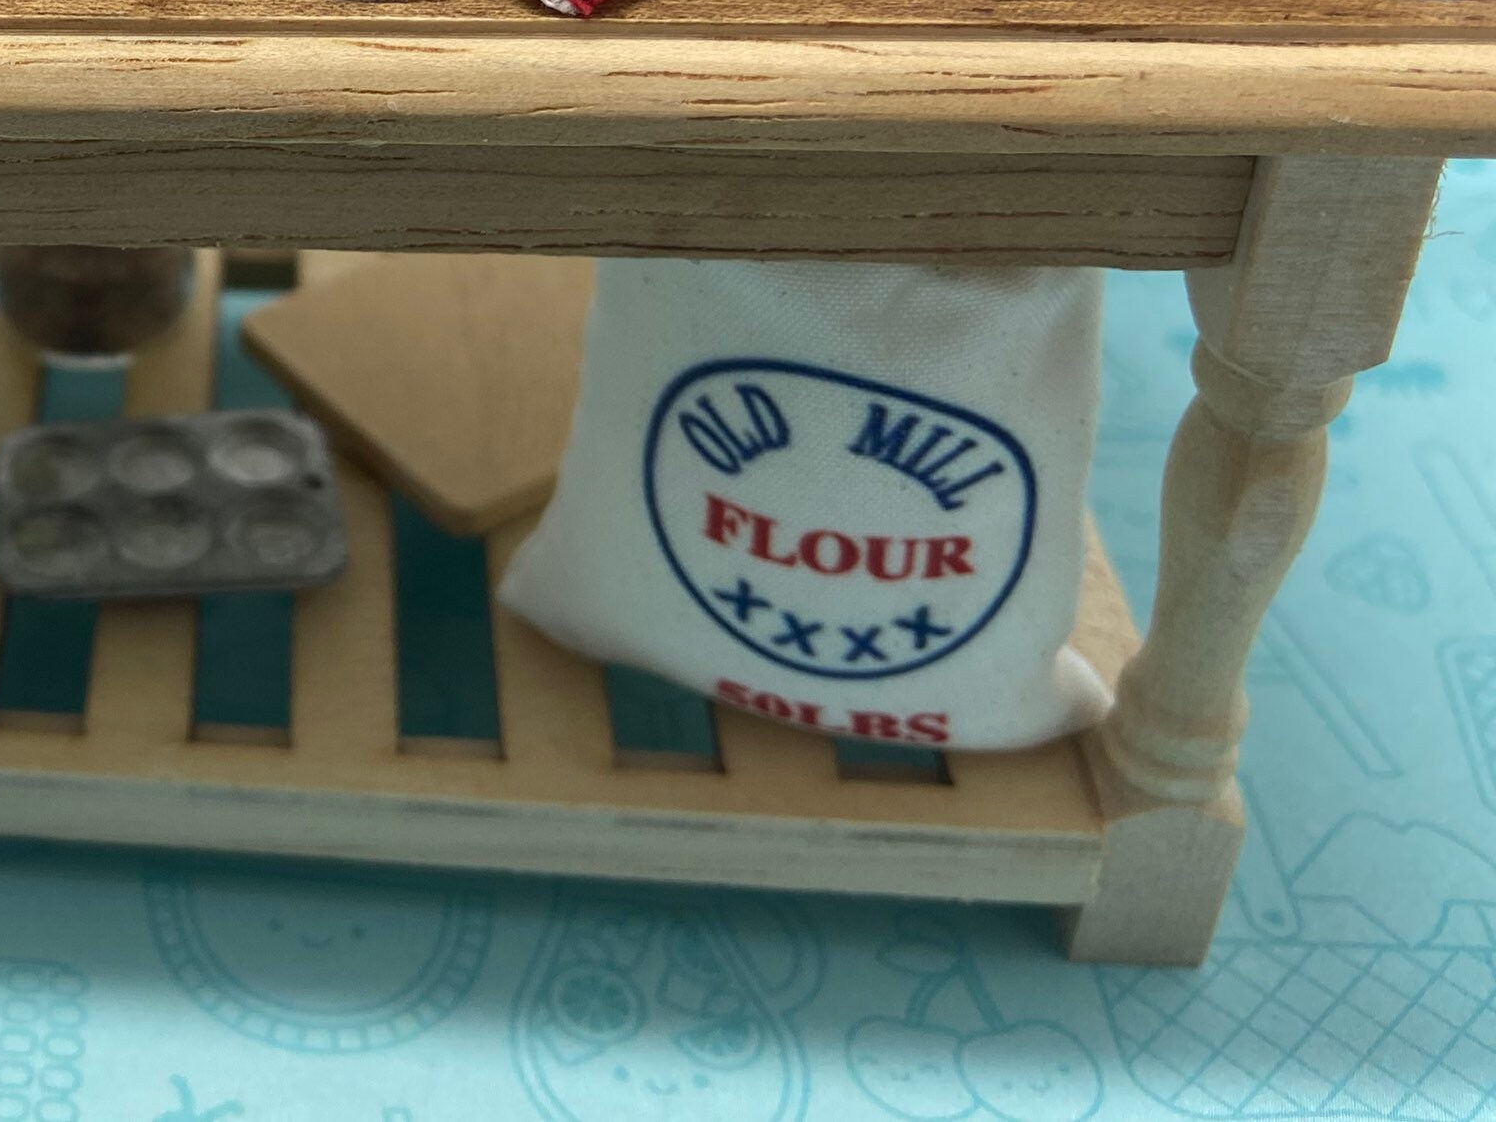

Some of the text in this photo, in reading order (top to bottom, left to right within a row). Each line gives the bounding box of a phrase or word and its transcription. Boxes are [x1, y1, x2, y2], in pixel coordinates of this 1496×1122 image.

[678, 384, 1006, 512] OLD MILL
[701, 493, 974, 581] FLOUR
